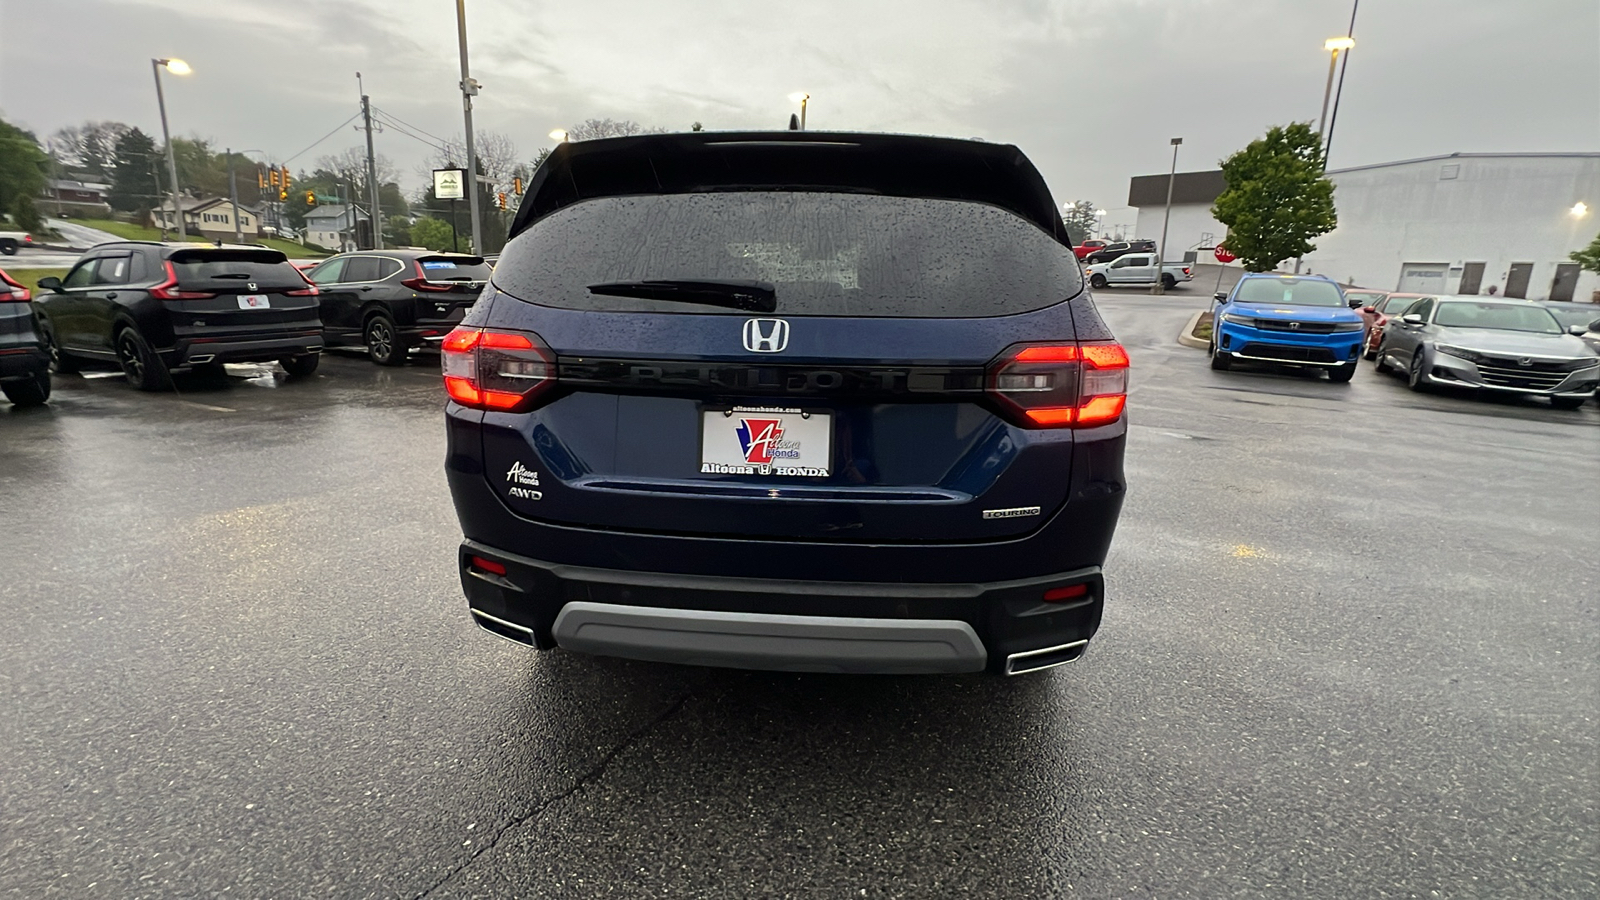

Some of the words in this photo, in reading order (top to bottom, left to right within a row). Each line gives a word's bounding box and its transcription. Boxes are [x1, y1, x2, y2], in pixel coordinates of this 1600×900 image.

[732, 405, 802, 413] altoonahonda.com
[767, 449, 799, 458] Honda
[700, 463, 754, 475] Altoona
[775, 466, 829, 477] HONDA
[508, 486, 543, 501] AWD
[986, 508, 1040, 518] TOURING
